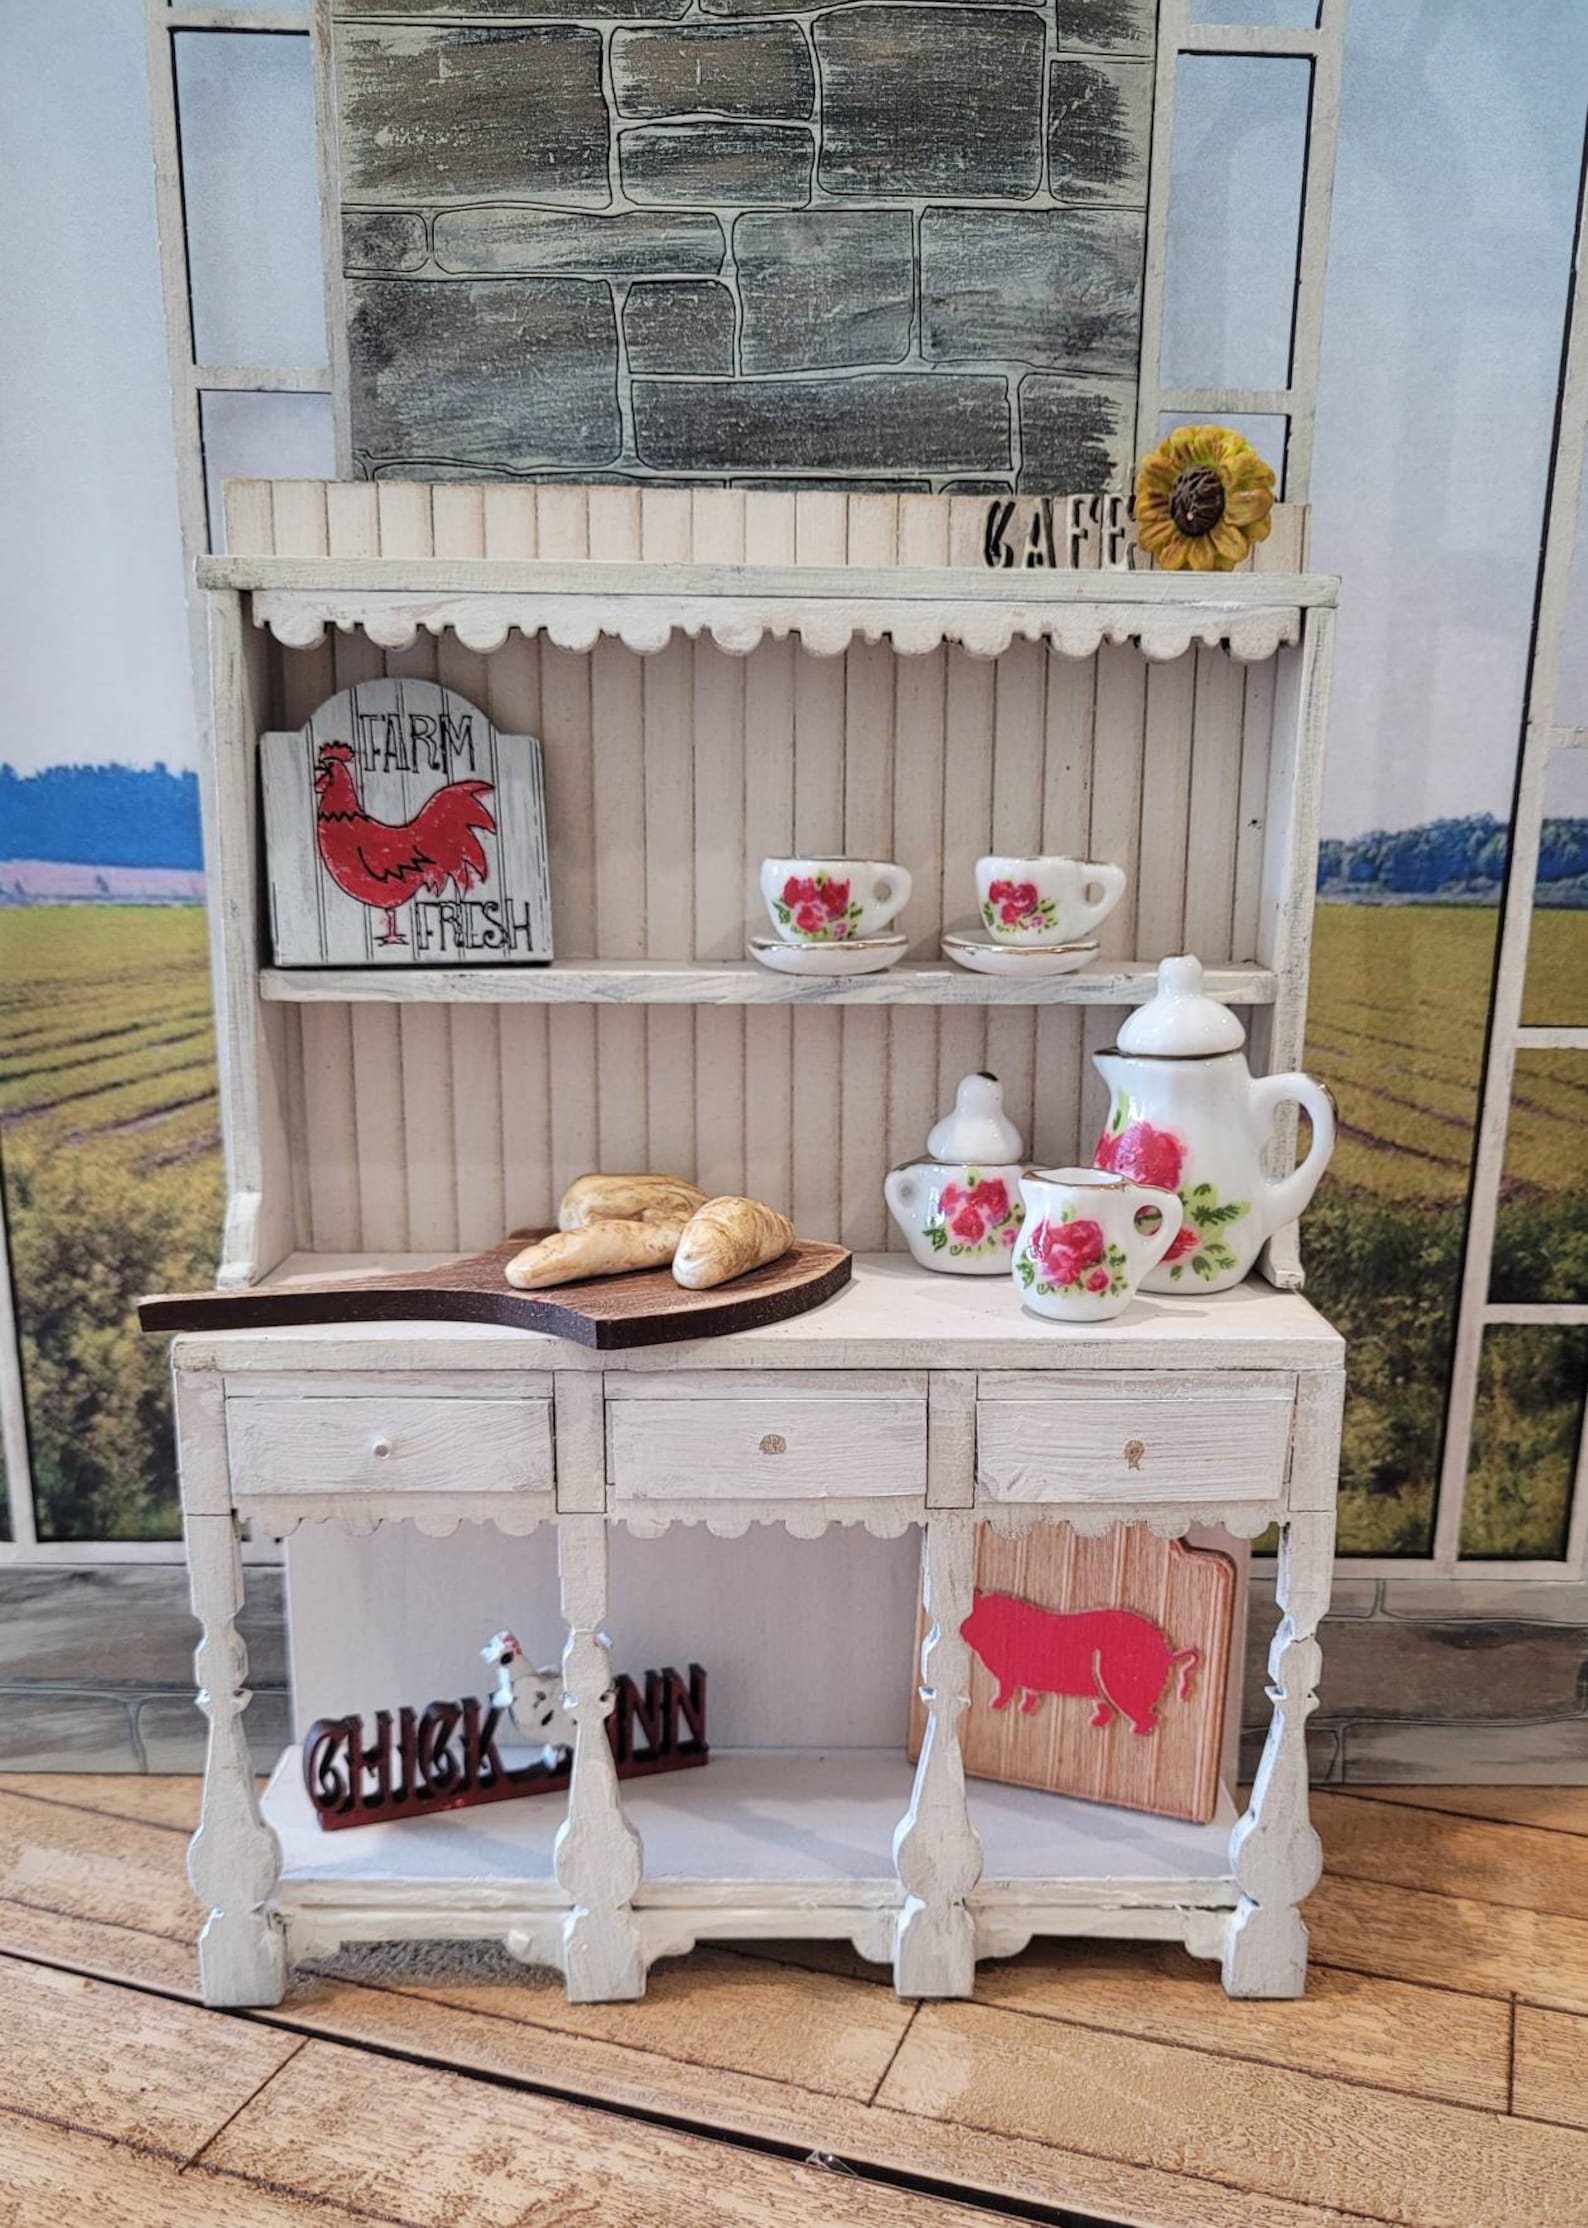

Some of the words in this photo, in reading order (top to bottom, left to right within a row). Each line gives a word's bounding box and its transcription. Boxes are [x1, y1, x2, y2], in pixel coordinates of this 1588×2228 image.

[359, 713, 476, 774] FARM
[416, 898, 534, 952] FRESH
[303, 1694, 503, 1814] CHICK
